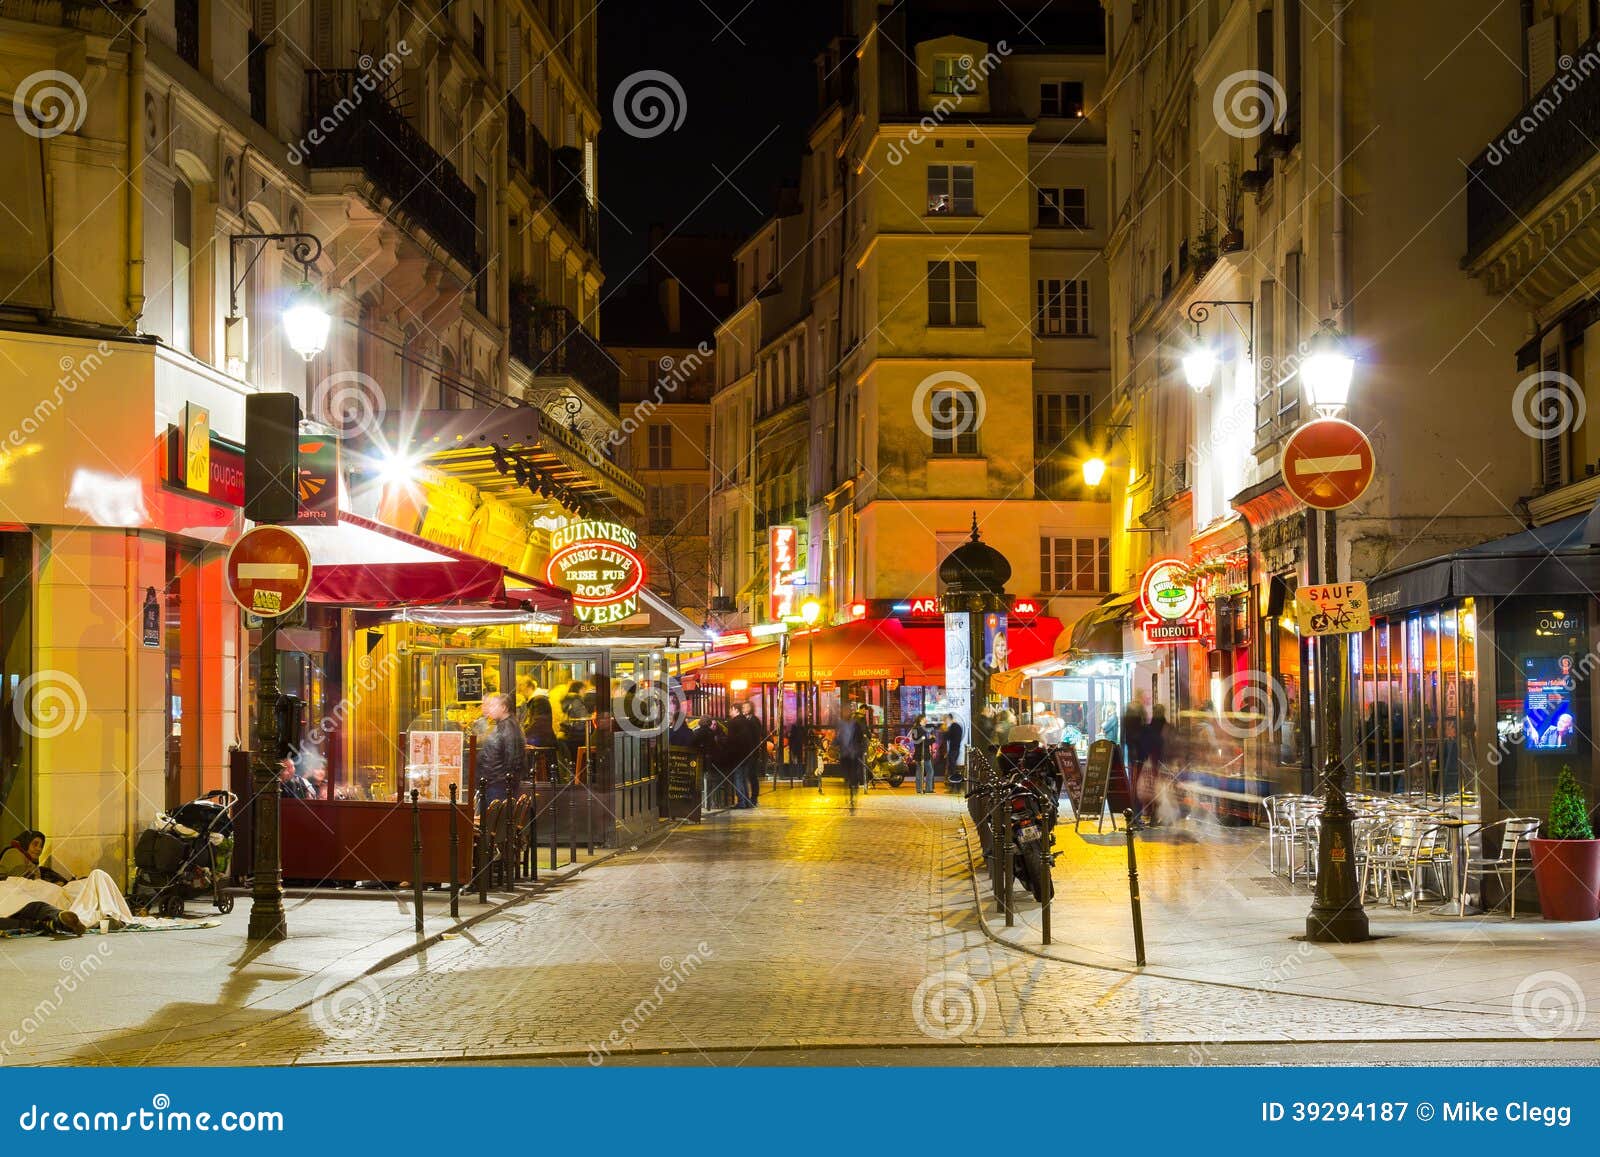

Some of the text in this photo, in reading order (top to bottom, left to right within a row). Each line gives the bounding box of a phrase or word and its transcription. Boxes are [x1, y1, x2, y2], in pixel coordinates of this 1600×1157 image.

[552, 521, 637, 550] GUINNESS
[558, 549, 633, 572] MUSIC LIVE
[565, 569, 626, 581] IRISH PUB
[575, 583, 617, 597] ROCK
[1309, 585, 1354, 601] SAUF
[575, 594, 637, 624] VERN
[1151, 626, 1195, 638] HIDEOUT
[853, 668, 891, 677] LIMONADE
